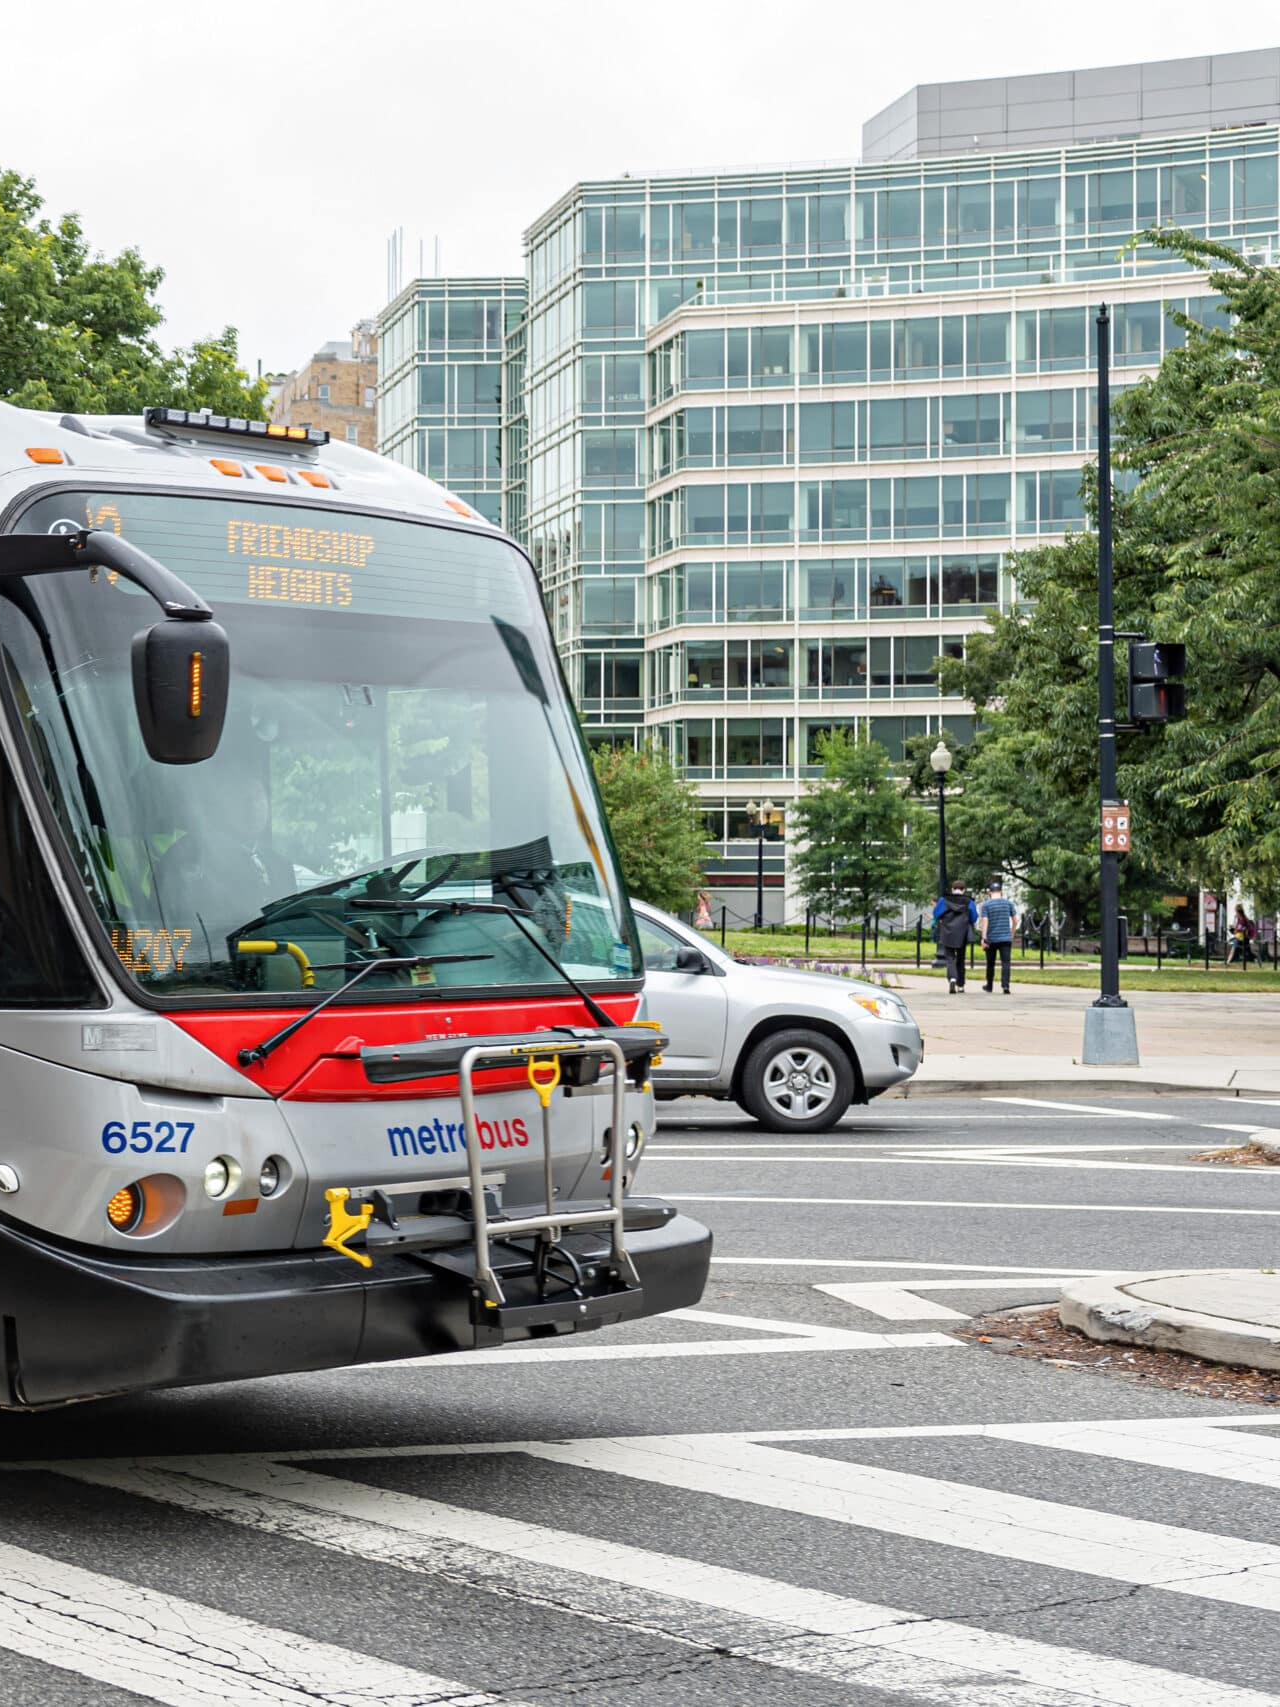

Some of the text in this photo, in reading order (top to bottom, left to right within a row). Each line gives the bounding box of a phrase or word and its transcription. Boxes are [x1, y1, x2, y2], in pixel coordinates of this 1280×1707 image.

[227, 521, 376, 567] FRIENDSHIP
[248, 566, 352, 605] HEIGHTS
[102, 1121, 195, 1154] 6527
